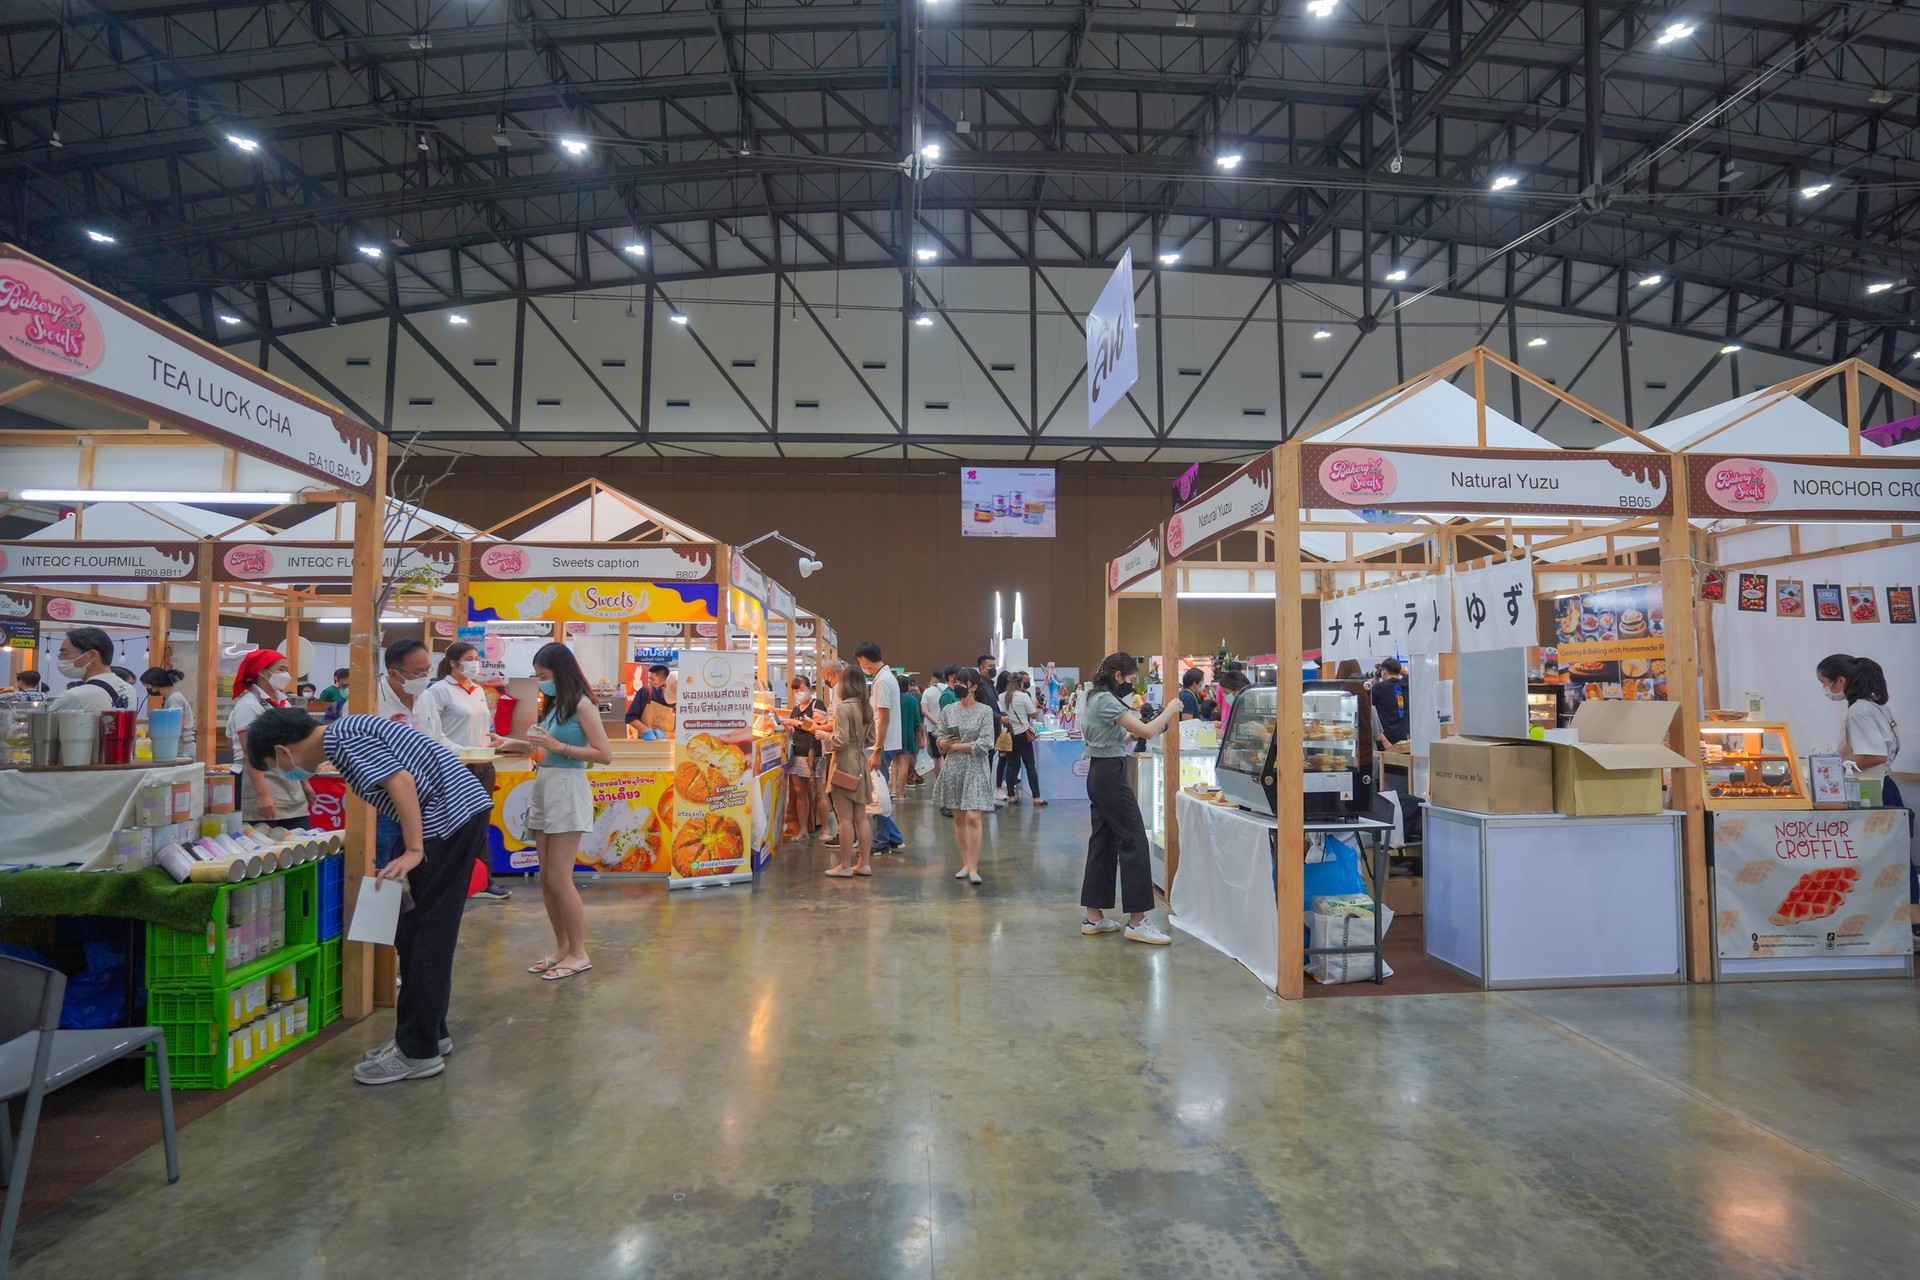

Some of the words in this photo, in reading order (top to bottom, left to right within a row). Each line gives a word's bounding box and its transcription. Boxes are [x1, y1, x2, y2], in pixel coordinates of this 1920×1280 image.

[28, 314, 82, 354] Sweets
[148, 354, 191, 395] TEA
[198, 377, 251, 420] LUCK
[256, 404, 292, 437] CHA
[1330, 461, 1369, 479] Bakery
[1351, 475, 1383, 491] Sweets
[1451, 471, 1512, 489] Natural
[1516, 473, 1559, 490] Yuzu
[1717, 471, 1752, 488] Bakery
[1793, 480, 1883, 497] NORCHOR
[1619, 496, 1652, 508] BB05
[1198, 507, 1218, 528] Natural
[1218, 501, 1232, 521] Yuzu
[22, 556, 71, 567] INTEQC
[74, 556, 146, 567] FLOURMILL
[288, 557, 334, 568] INTEQC
[552, 557, 594, 568] Sweets
[597, 557, 639, 570] caption
[675, 570, 699, 579] BB07
[585, 587, 634, 610] Sweets
[1466, 582, 1523, 629] ゆず
[84, 608, 99, 616] Little
[100, 609, 118, 618] Sweet
[119, 612, 140, 620] Daifuku
[1560, 649, 1582, 657] Cooking
[1587, 648, 1608, 656] Baking
[1622, 644, 1658, 653] Homemade
[1775, 821, 1849, 838] NORCHOR
[1775, 840, 1858, 859] CROFFLE
